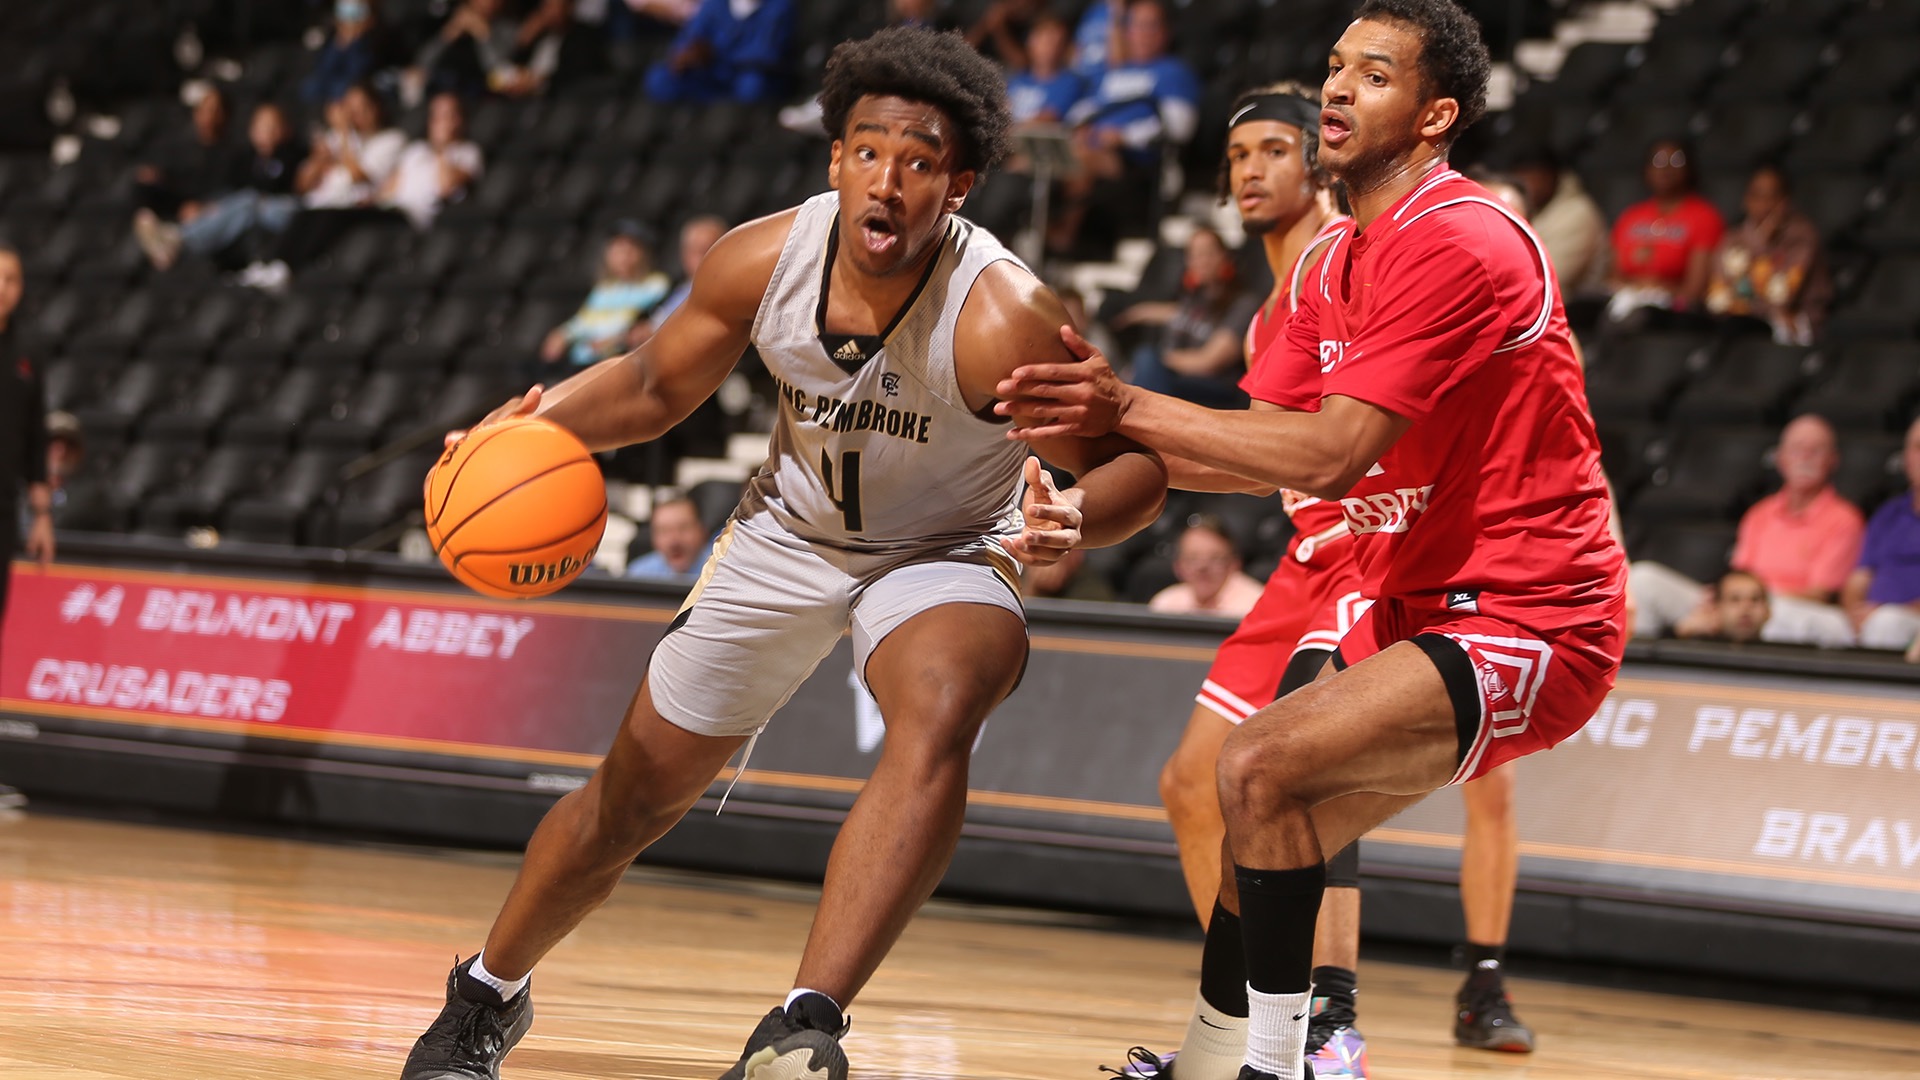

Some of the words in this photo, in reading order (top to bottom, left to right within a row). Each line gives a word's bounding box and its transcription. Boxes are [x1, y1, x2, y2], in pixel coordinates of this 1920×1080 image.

[833, 351, 866, 361] adidas
[812, 394, 932, 444] PEMBROKE
[822, 446, 863, 532] 4
[60, 584, 124, 626] #4
[137, 588, 354, 645] BELMONT
[367, 608, 535, 659] ABBEY
[1453, 592, 1471, 602] XL
[26, 658, 292, 722] CRUSADERS
[1565, 697, 1658, 749] NC
[1688, 704, 1920, 772] PEMBR
